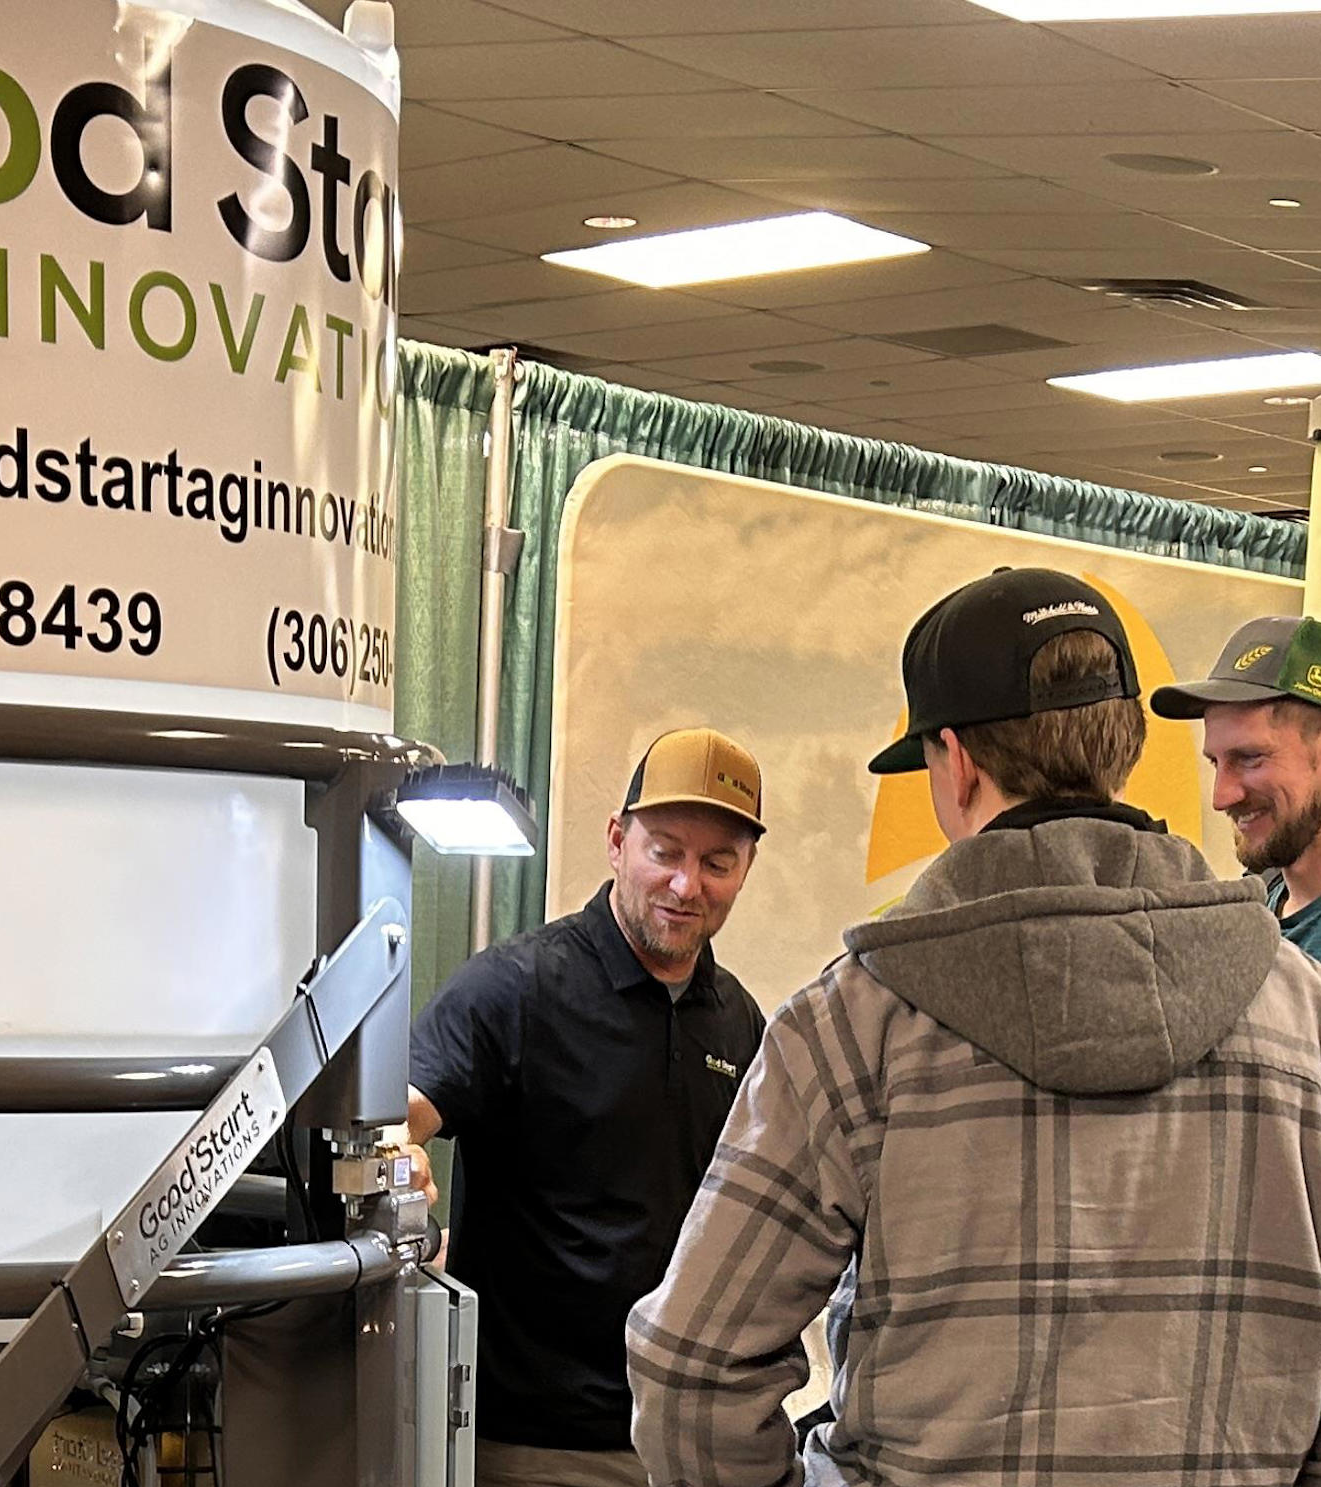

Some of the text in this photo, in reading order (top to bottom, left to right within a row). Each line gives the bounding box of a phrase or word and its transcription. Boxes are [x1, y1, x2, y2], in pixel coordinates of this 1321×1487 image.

[217, 63, 395, 313] Sta
[267, 606, 393, 696] (306)250-
[139, 1091, 254, 1240] Good Start
[149, 1120, 260, 1265] AG INNOVATIONS
